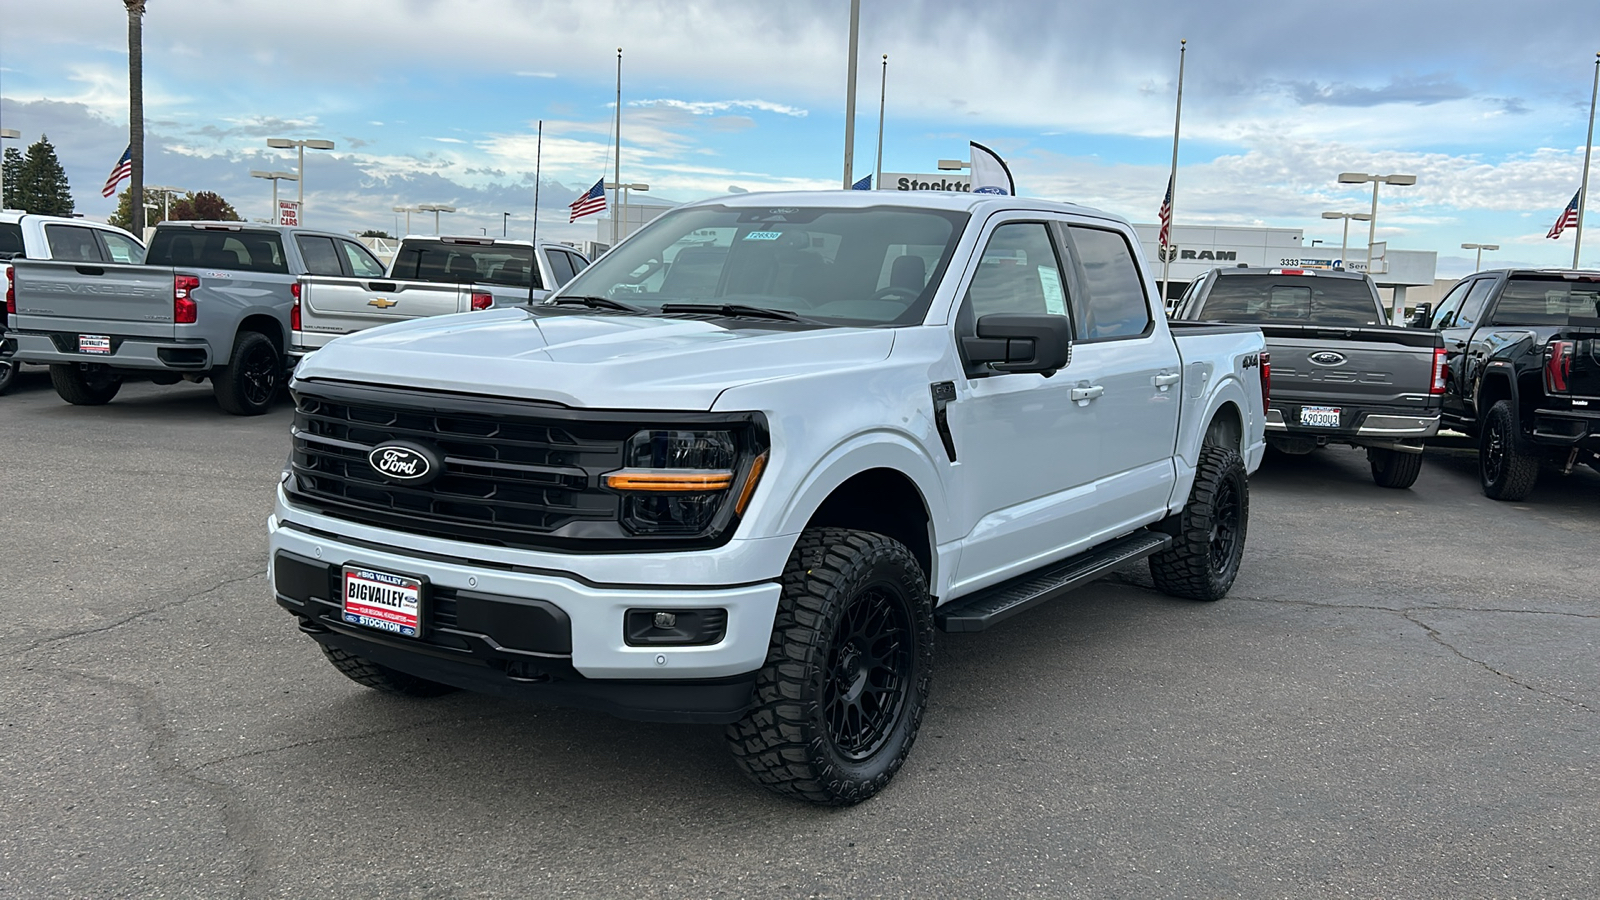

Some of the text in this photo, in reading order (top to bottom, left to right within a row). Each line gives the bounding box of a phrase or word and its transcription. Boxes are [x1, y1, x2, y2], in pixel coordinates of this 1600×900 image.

[280, 202, 298, 210] QUALITY
[282, 210, 296, 218] USED
[280, 217, 298, 226] CARS
[1181, 249, 1237, 261] RAM
[1280, 258, 1299, 267] 3333
[1242, 354, 1259, 370] 4X4
[1303, 413, 1338, 424] 49030U3
[379, 449, 417, 475] Ford
[361, 571, 402, 585] BIG VALLEY
[348, 582, 405, 608] BIGVALLEY
[359, 616, 401, 633] STOCKTON
